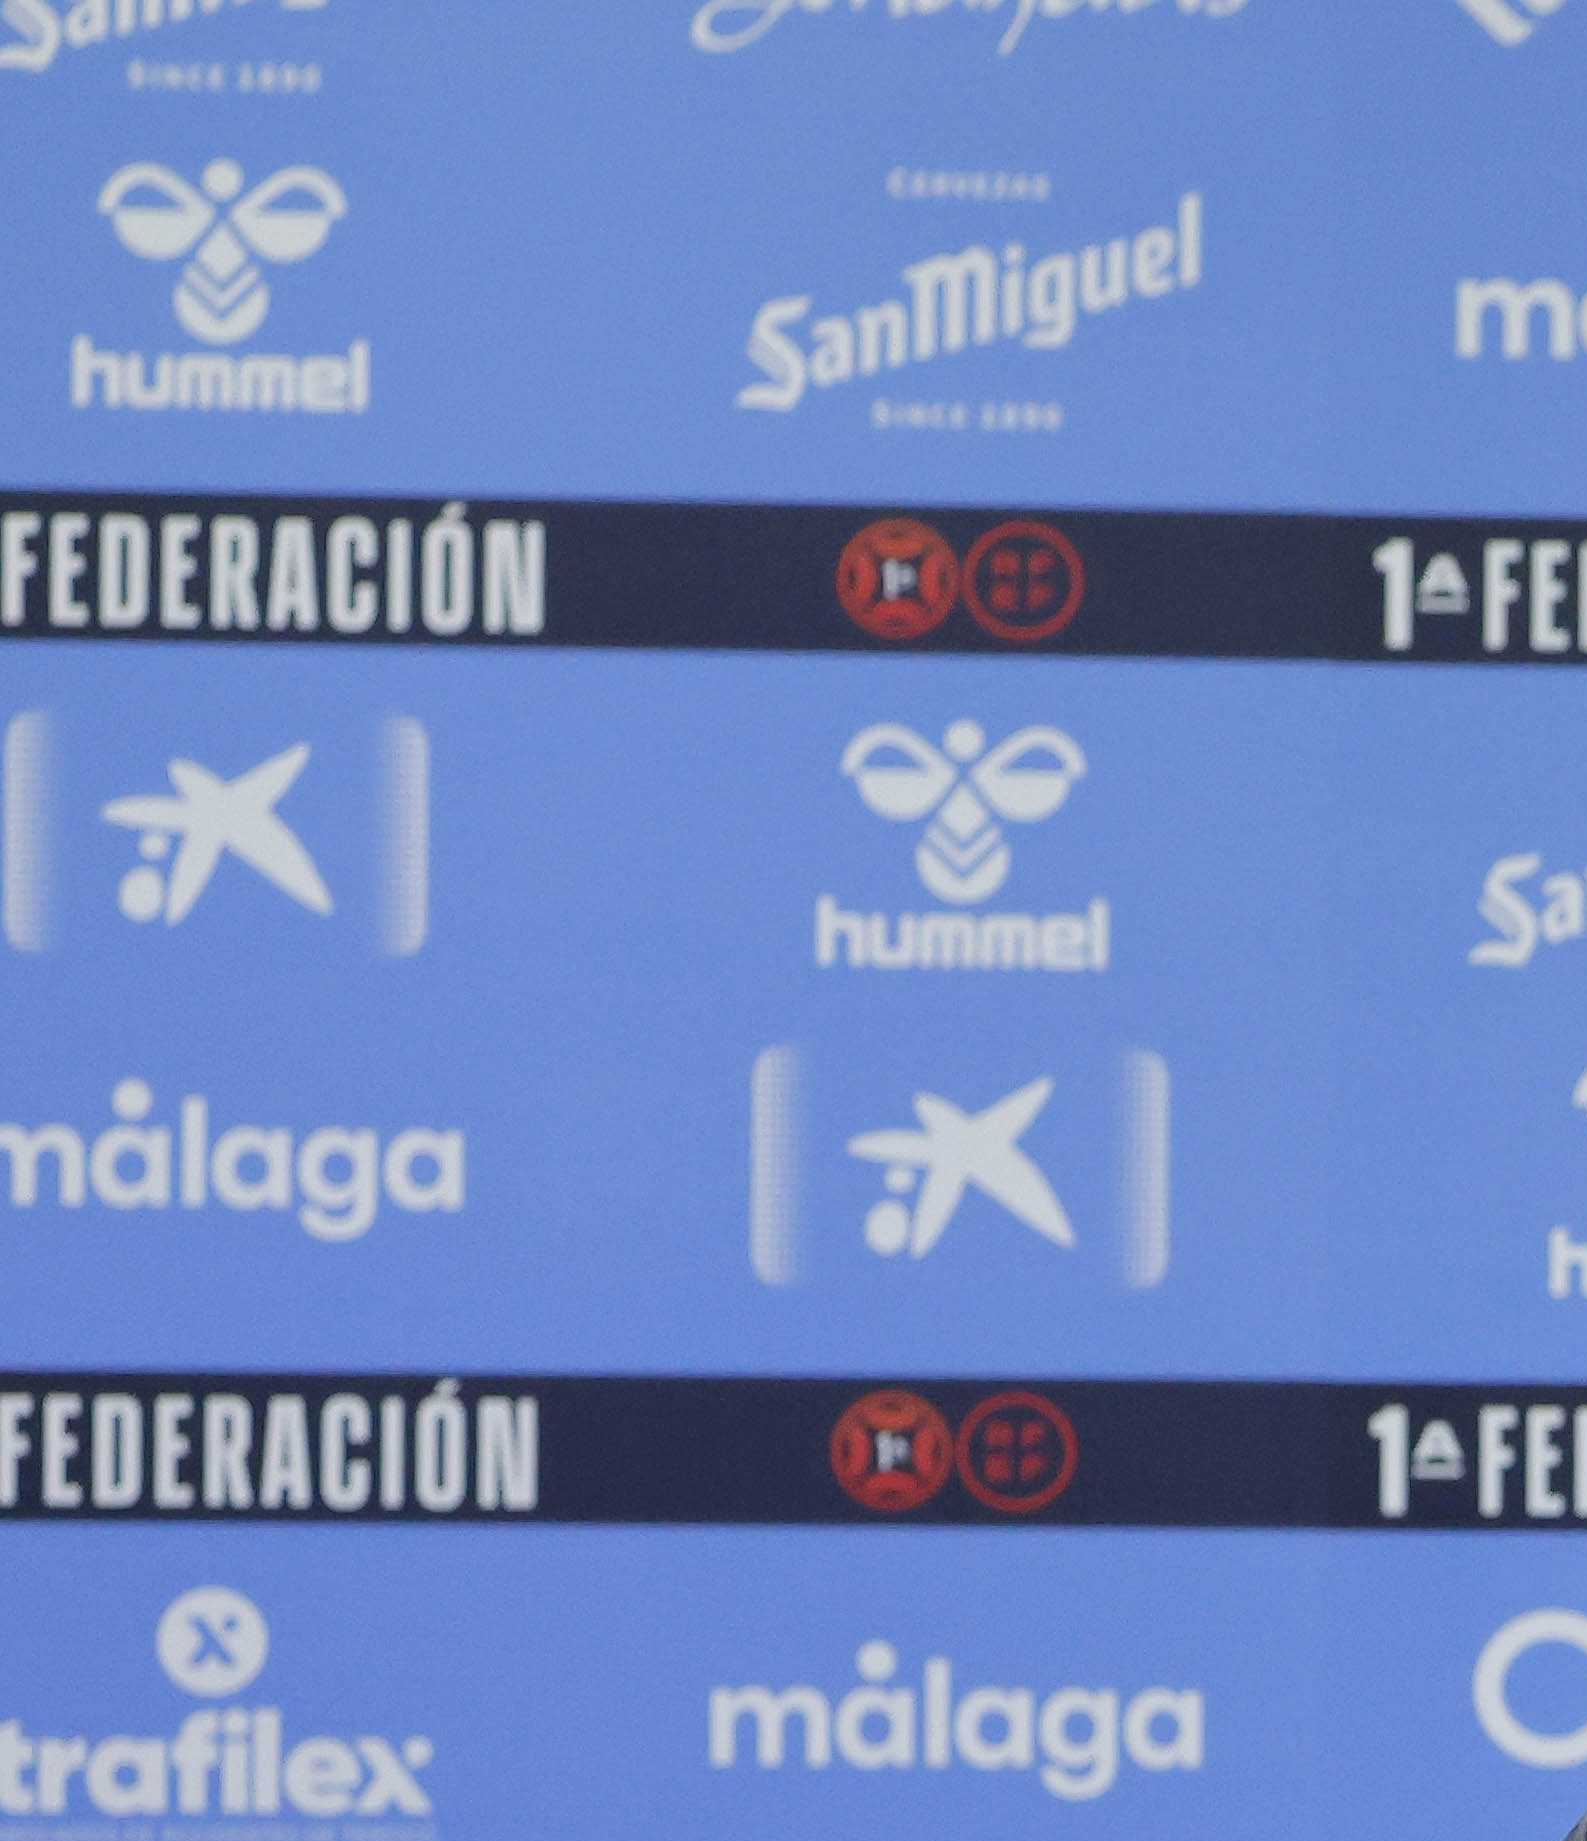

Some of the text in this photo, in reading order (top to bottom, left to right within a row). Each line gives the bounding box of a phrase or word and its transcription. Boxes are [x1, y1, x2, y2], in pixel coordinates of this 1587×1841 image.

[72, 336, 370, 413] hummel
[1, 501, 550, 640] FEDERACIÓN
[815, 895, 1109, 971] hummel
[710, 1641, 1204, 1800] málaga
